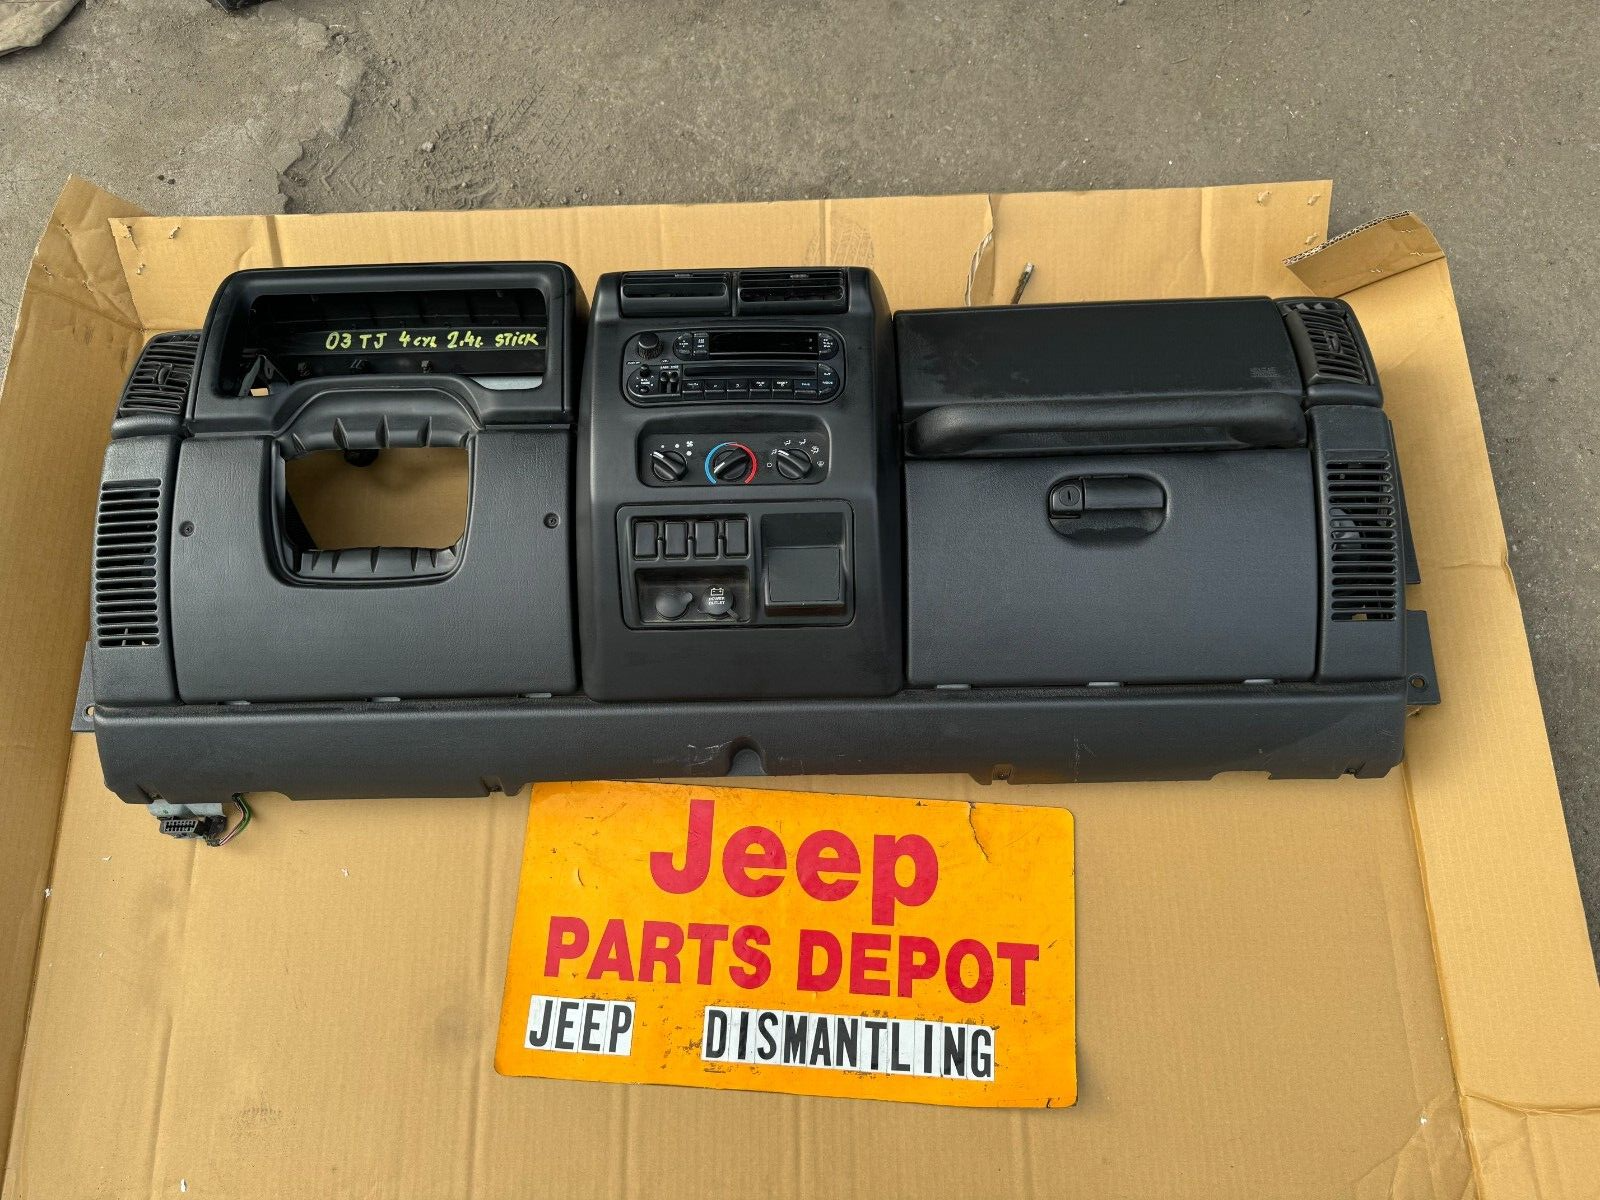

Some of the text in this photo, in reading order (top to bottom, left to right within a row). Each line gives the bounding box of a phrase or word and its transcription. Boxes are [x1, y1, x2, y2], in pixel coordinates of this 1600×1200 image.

[325, 331, 352, 350] 03
[359, 332, 388, 349] TJ
[649, 799, 939, 927] Jeep
[543, 916, 1040, 1006] PARTS DEPOT
[529, 999, 632, 1053] JEEP
[705, 1009, 992, 1078] DISMANTLING
